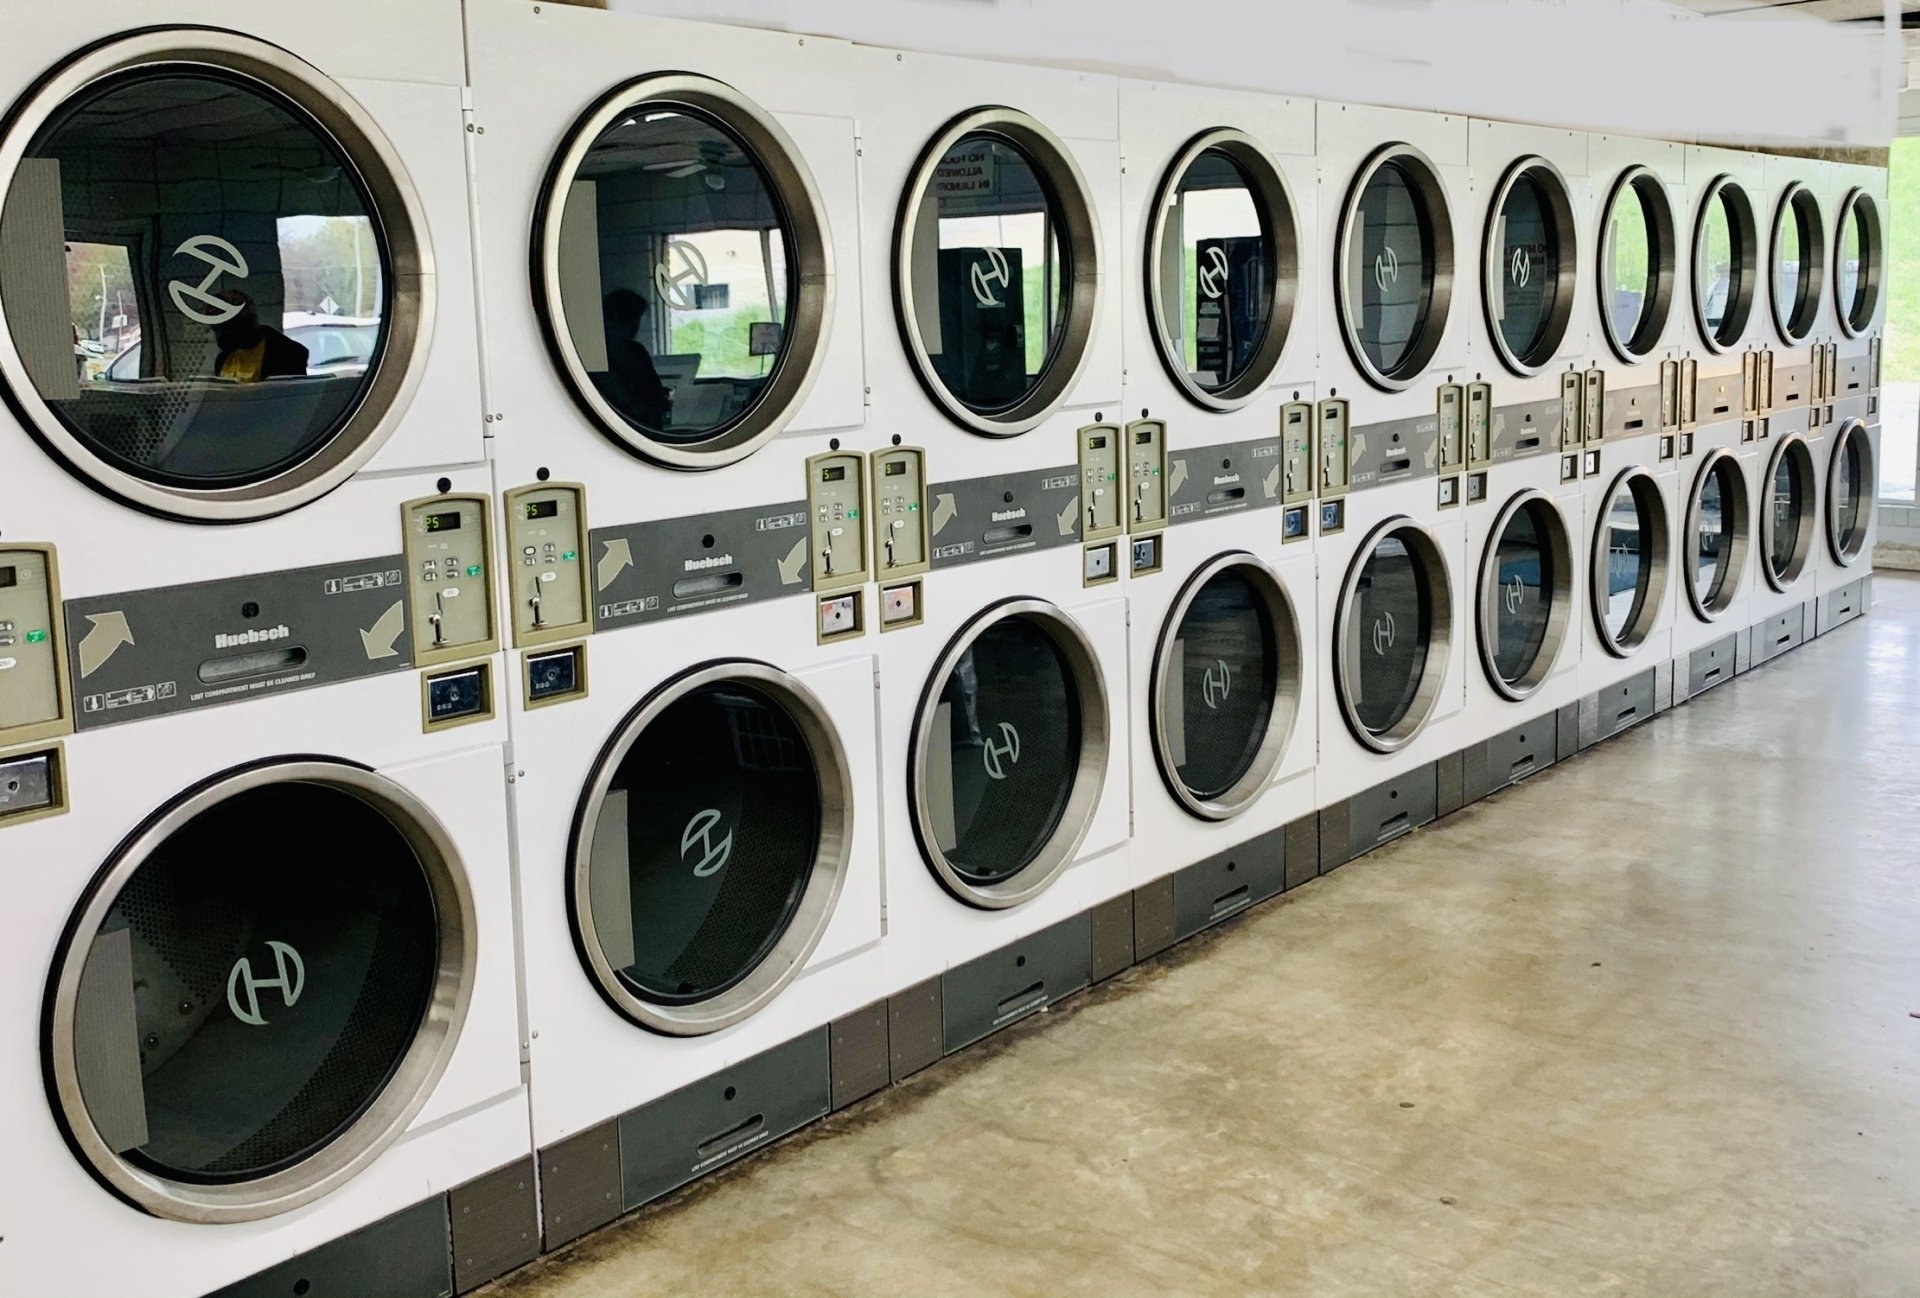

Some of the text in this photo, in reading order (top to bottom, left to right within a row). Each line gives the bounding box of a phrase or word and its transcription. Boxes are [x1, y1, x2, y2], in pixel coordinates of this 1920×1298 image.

[992, 507, 1026, 522] Huebsch
[684, 553, 733, 571] Huebsch
[215, 624, 289, 649] Huebsch
[204, 684, 249, 698] COMPARTMENT
[249, 681, 266, 689] MUST
[266, 679, 274, 687] BE
[274, 675, 300, 685] CLEANED
